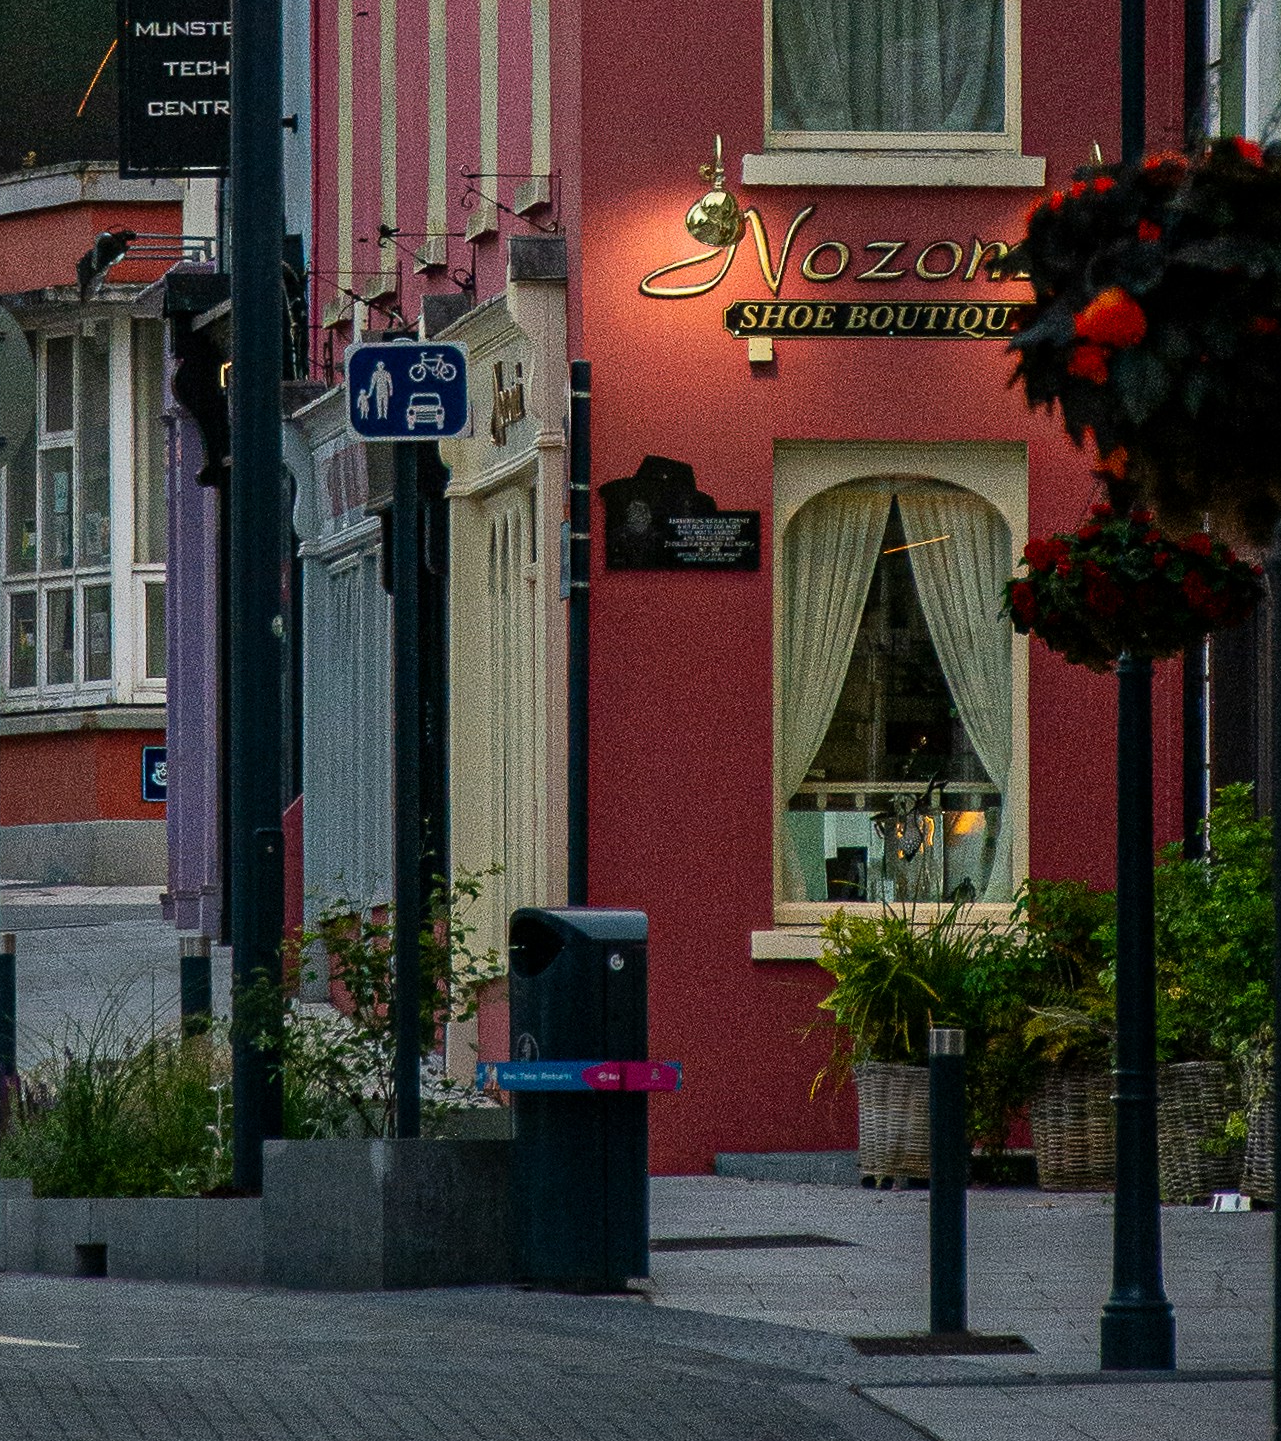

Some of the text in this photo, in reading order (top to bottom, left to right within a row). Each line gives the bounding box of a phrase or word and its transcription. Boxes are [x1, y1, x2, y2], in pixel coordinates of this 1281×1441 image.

[162, 60, 231, 77] TECH
[739, 303, 1020, 339] SHOE BOUTIQU
